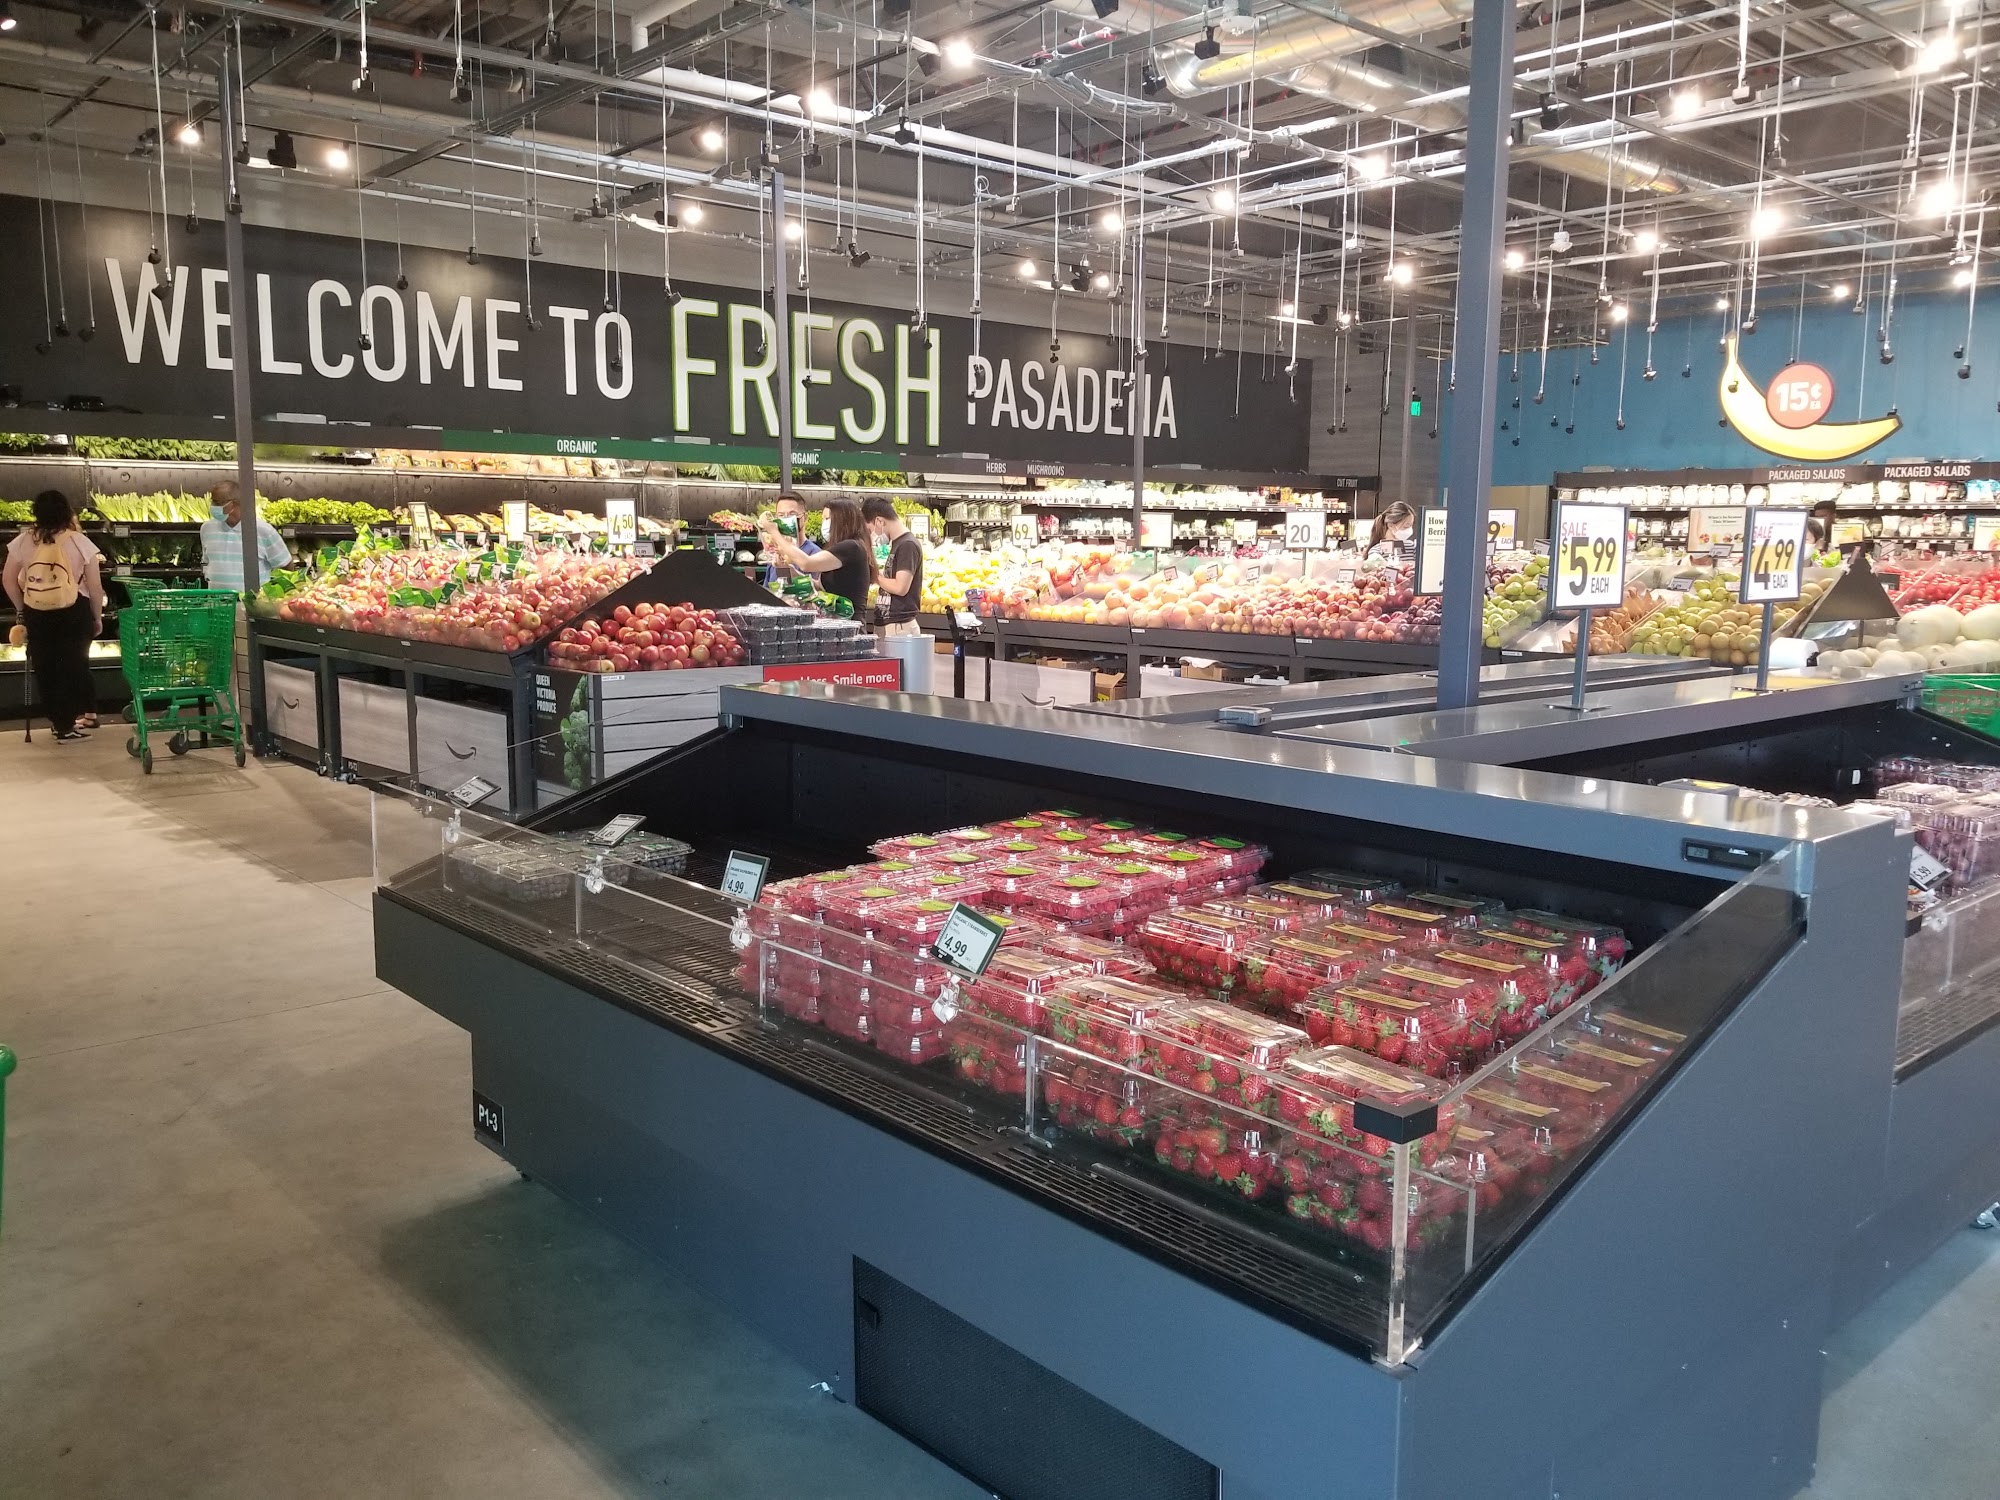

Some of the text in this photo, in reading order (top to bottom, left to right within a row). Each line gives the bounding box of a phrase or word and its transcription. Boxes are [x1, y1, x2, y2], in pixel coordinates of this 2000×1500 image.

[105, 258, 633, 399] WELCOME TO
[670, 296, 941, 446] FRESH
[1776, 381, 1823, 411] 15¢
[557, 440, 597, 454] ORGANIC
[790, 452, 819, 465] RGANIC
[986, 462, 1007, 474] HERBS
[1027, 464, 1065, 476] MUSHROOMS
[1768, 468, 1846, 481] PACKAGED SALADS
[1884, 465, 1971, 478] PACKAGED SALADS
[1336, 478, 1346, 487] CUT
[1428, 517, 1444, 525] How
[1290, 524, 1311, 544] 20
[1427, 527, 1446, 536] Berri
[1561, 522, 1588, 537] SALE
[1752, 526, 1774, 539] SALE
[1590, 577, 1610, 594] EACH
[1773, 574, 1789, 589] EACH
[535, 674, 551, 687] QUEEN
[833, 673, 863, 686] Smile
[865, 673, 896, 685] more.
[536, 687, 557, 700] VICTORIA
[536, 700, 557, 714] PRODUCE
[954, 914, 967, 925] ORGANIC
[478, 1103, 498, 1132] P1-3
